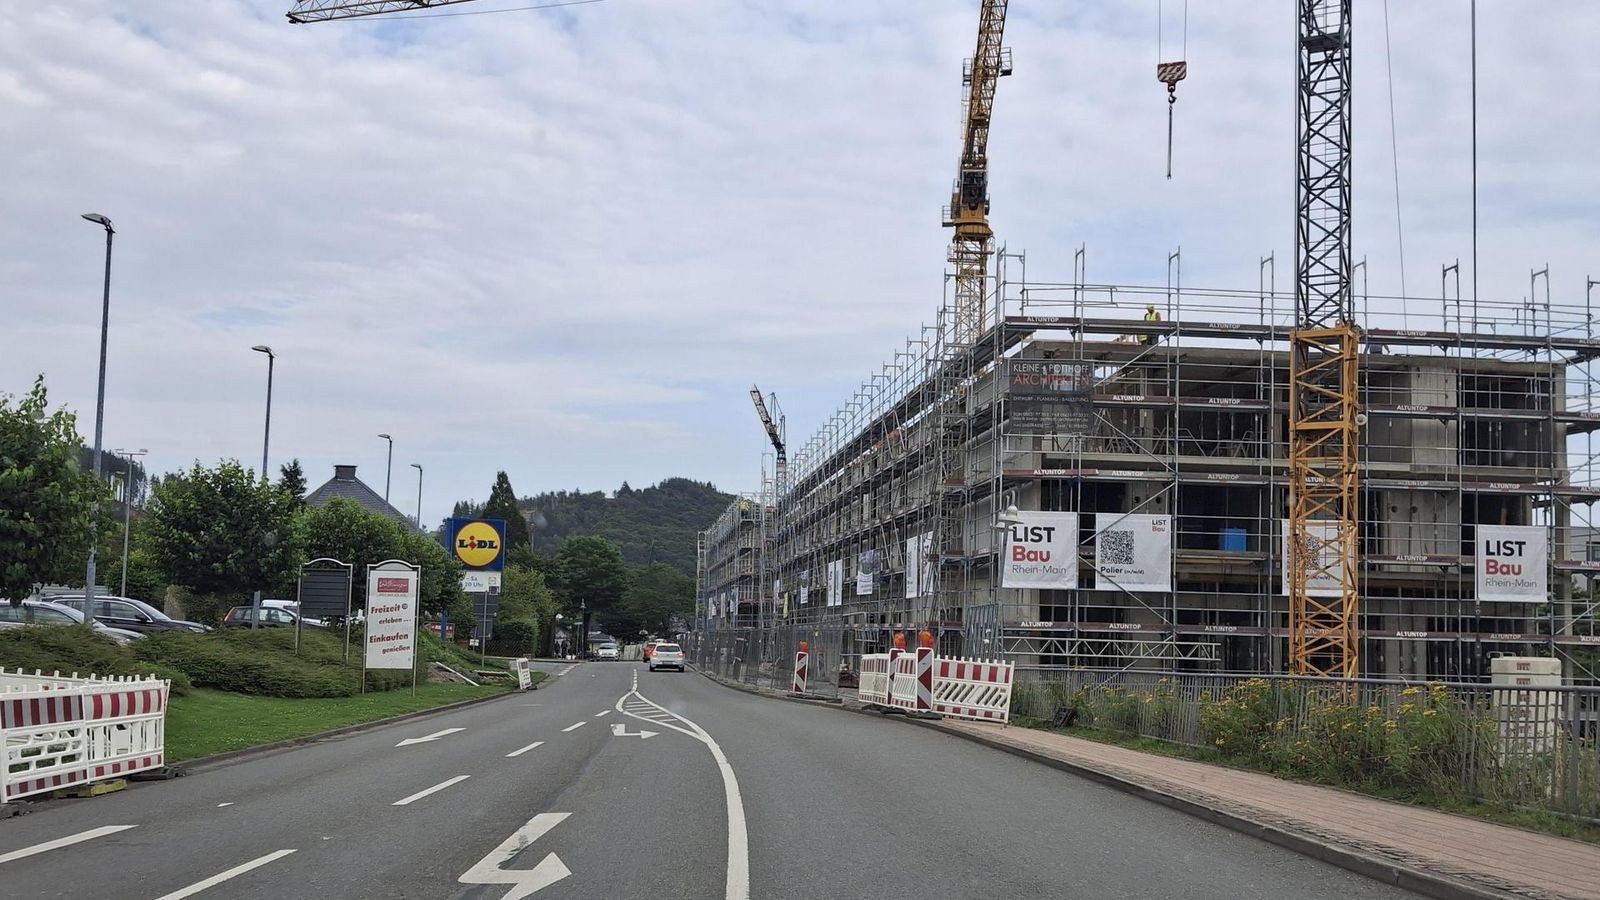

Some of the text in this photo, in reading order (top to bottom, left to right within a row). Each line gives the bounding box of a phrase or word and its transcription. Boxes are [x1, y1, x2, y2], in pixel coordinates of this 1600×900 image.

[1013, 363, 1039, 373] KLEINE
[1049, 364, 1089, 373] POTTHOFF
[1013, 373, 1089, 385] ARCHITEKTEN
[1012, 526, 1055, 543] LIST
[1012, 545, 1051, 562] Bau
[1485, 540, 1526, 557] LIST
[1012, 564, 1067, 575] Rhein-Main
[1100, 566, 1123, 574] Polier
[1485, 559, 1522, 575] Bau
[1485, 578, 1537, 588] Rhein-Main
[371, 603, 400, 614] Freizeit
[379, 617, 402, 625] erleben
[369, 632, 409, 643] Einkaufen
[382, 645, 410, 654] genießen
